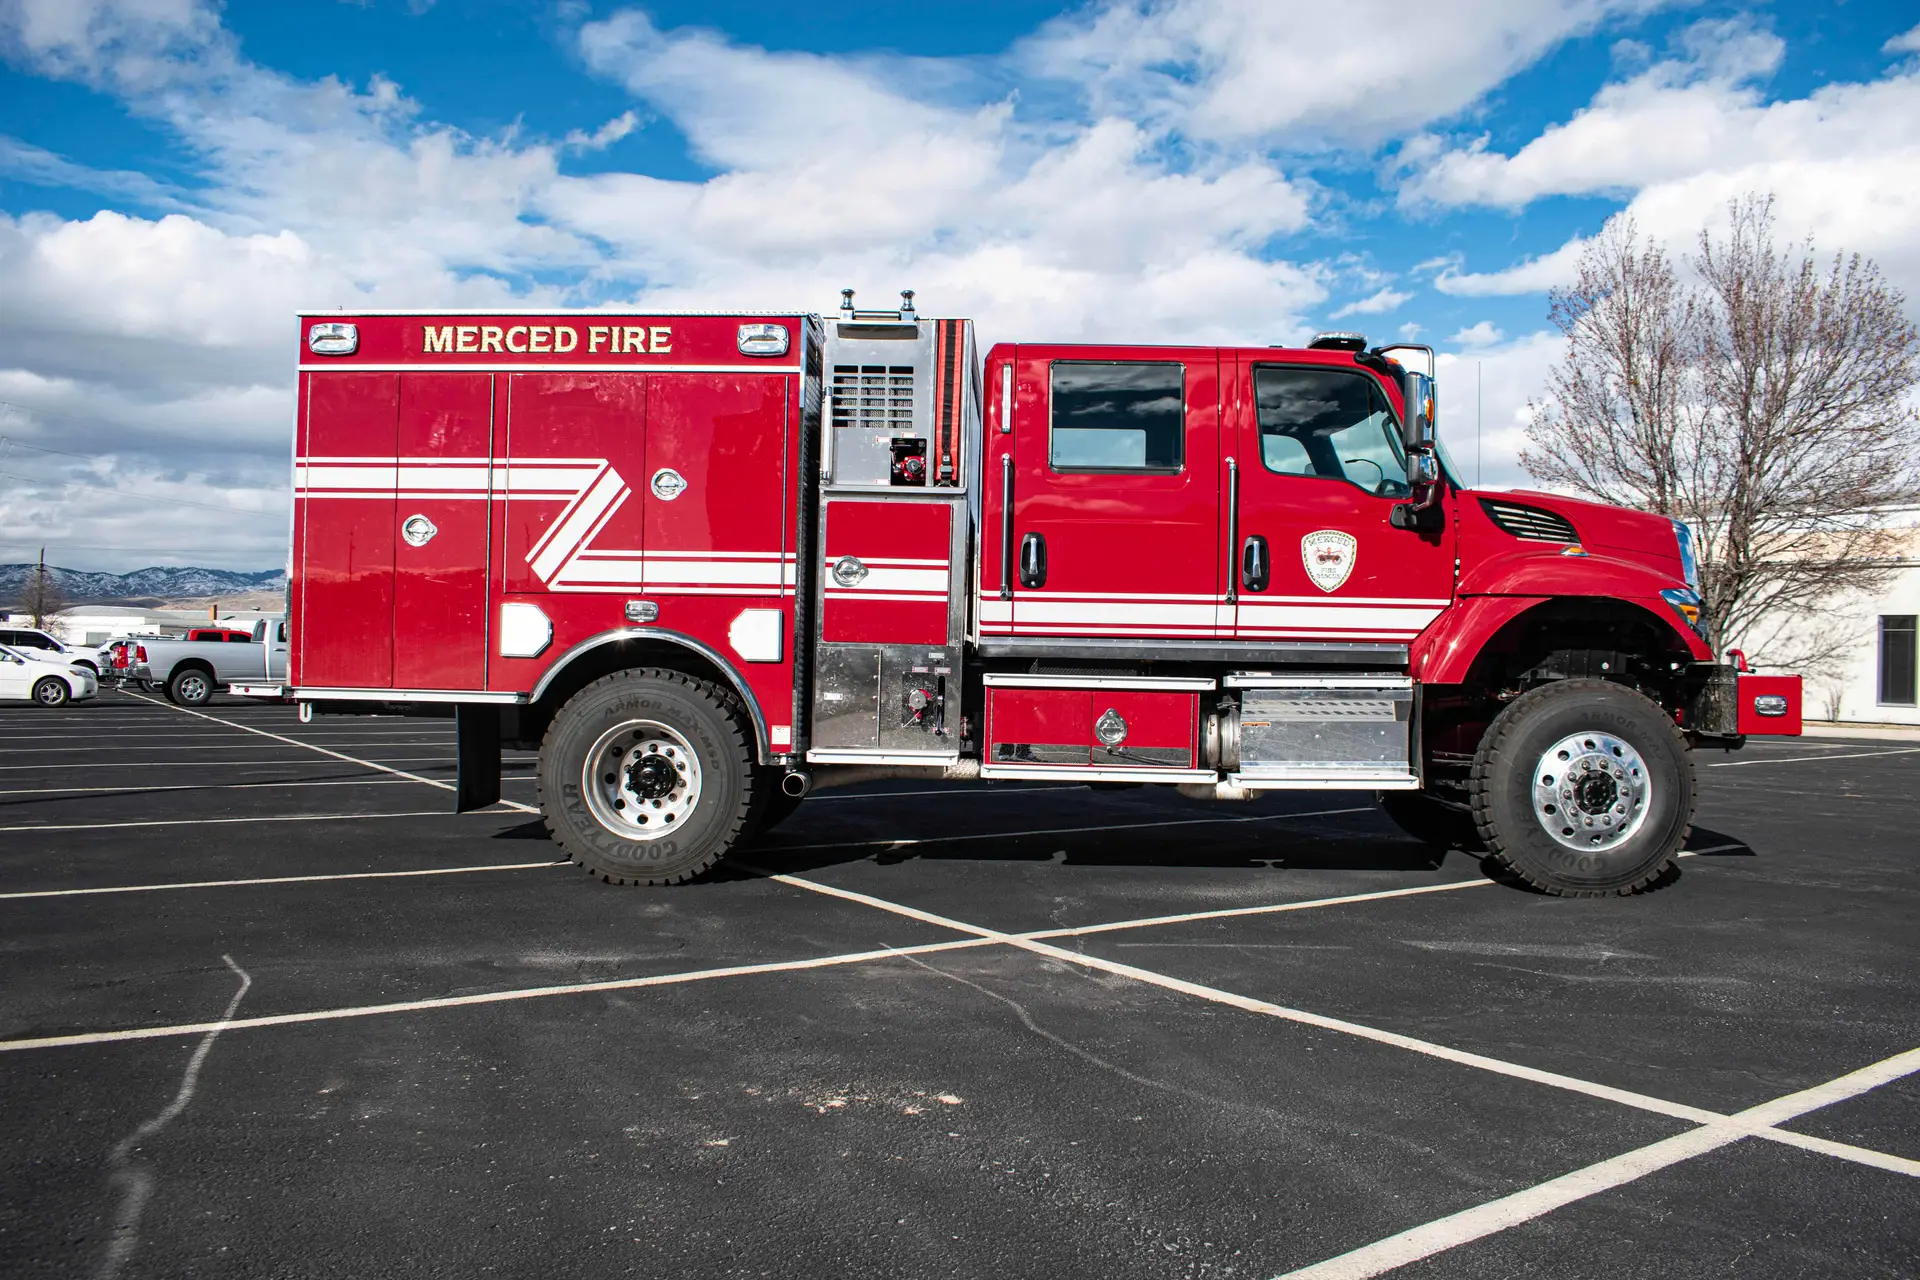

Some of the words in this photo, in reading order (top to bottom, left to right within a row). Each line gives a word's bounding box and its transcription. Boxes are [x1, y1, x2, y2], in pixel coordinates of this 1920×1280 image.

[422, 326, 578, 353] MERCED
[587, 326, 672, 353] FIRE
[1308, 535, 1351, 547] MERCED
[604, 699, 662, 718] ARMOR
[562, 782, 678, 860] GOODYEAR
